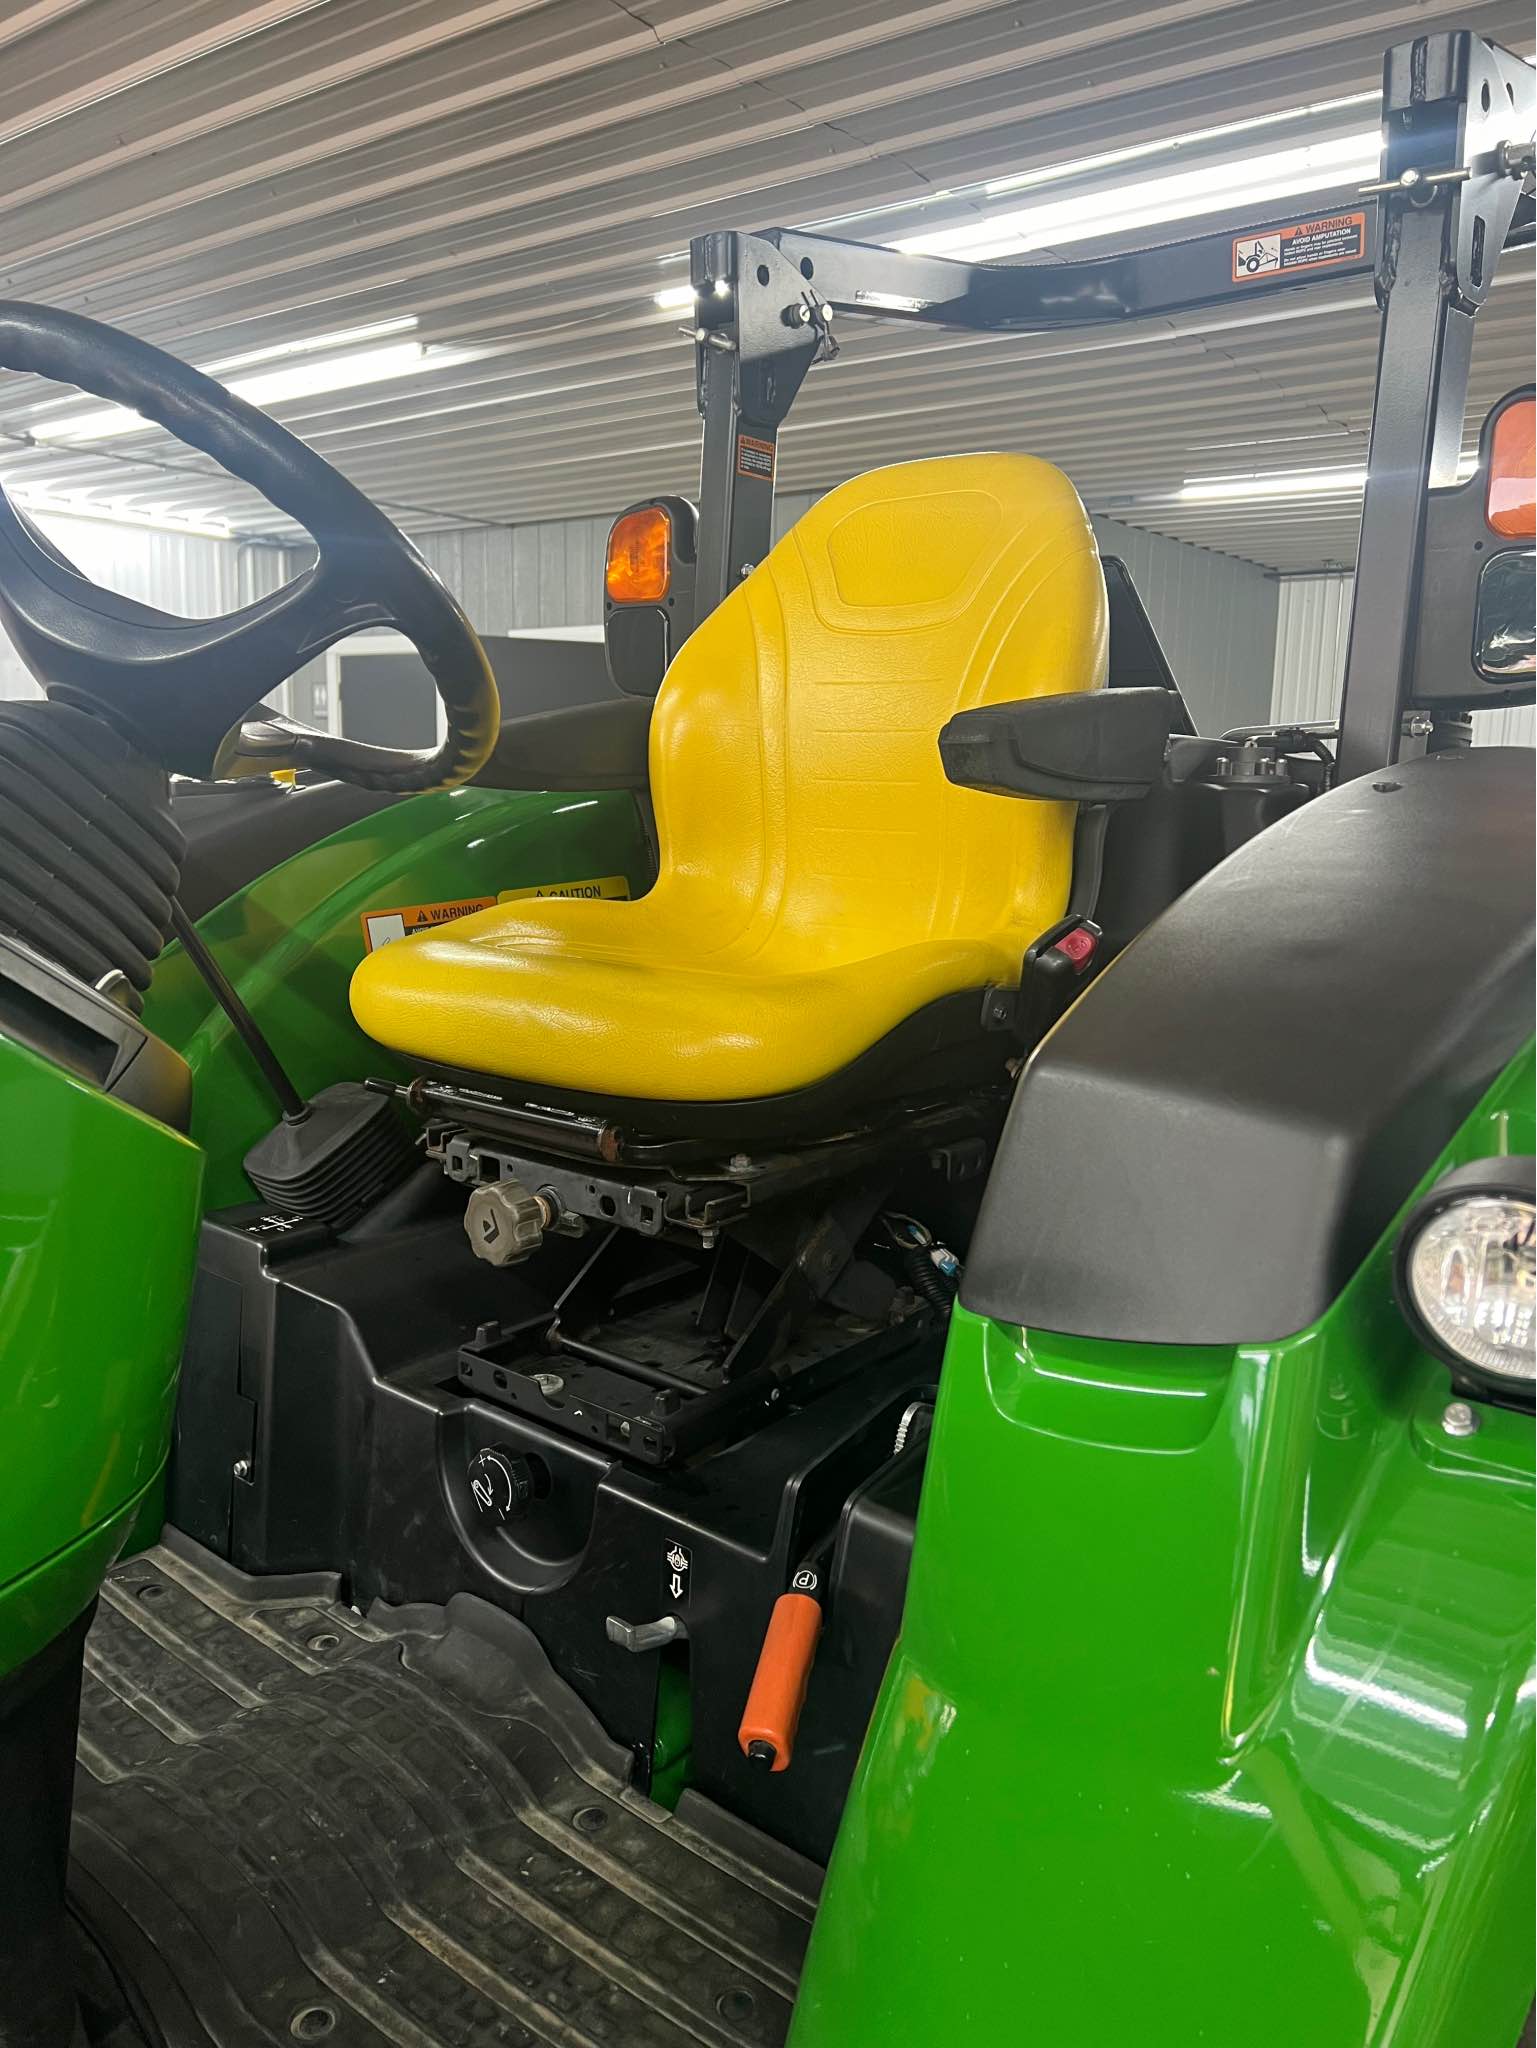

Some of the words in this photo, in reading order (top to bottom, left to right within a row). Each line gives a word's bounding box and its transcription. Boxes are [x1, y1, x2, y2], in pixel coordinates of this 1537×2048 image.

[1305, 216, 1353, 233] WARNING
[1292, 235, 1311, 246] AVOID
[1311, 227, 1351, 241] AMPUTATION
